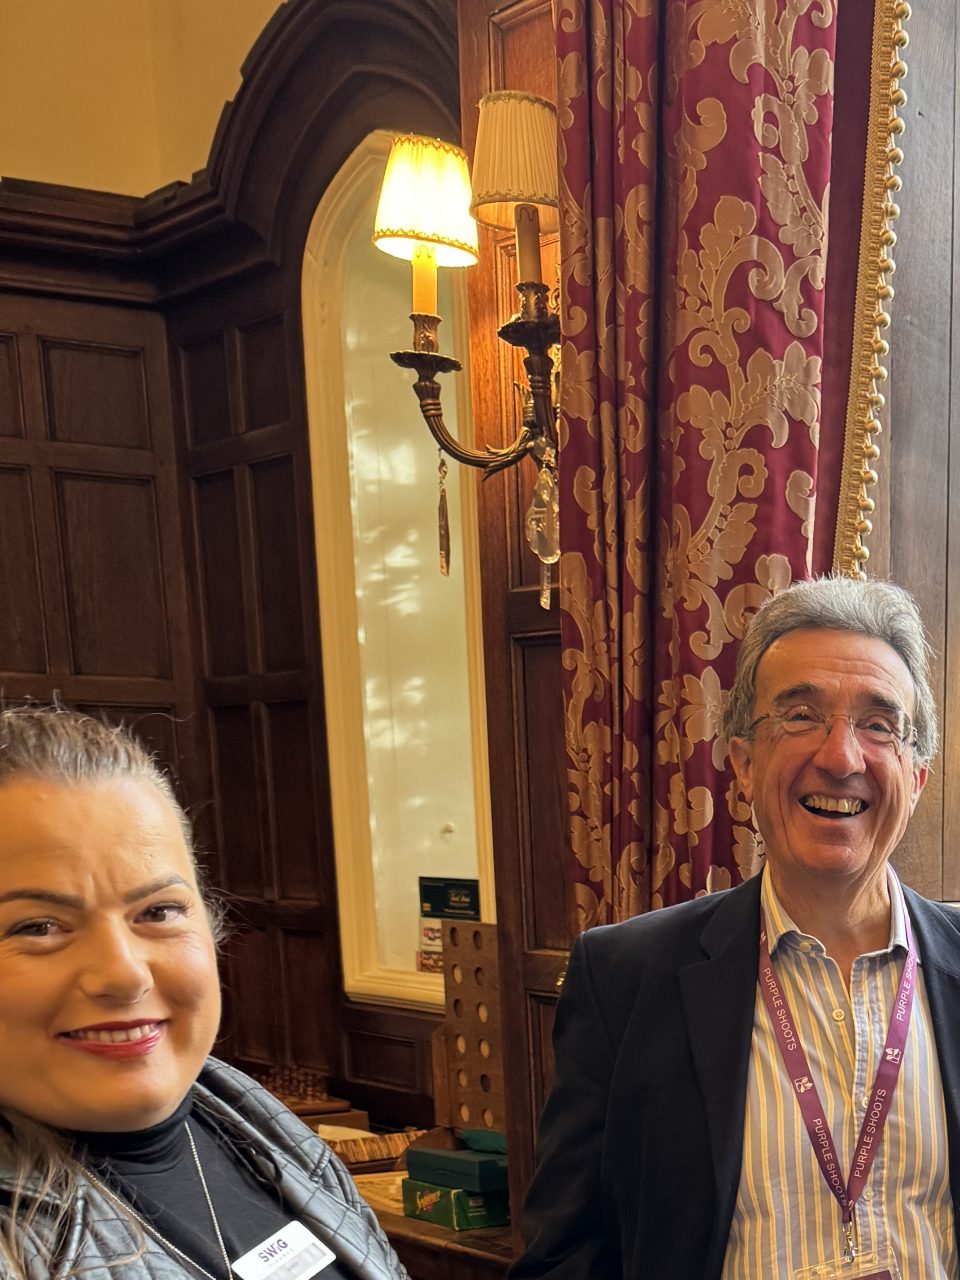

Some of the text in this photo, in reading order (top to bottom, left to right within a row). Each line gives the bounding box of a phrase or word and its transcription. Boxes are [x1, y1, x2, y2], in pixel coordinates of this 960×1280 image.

[763, 967, 797, 1051] PURPLE SHOOTS
[896, 981, 911, 1021] PURPLE
[813, 1118, 848, 1206] PURPLE SHOOTS
[853, 1088, 887, 1178] PURPLE SHOOTS
